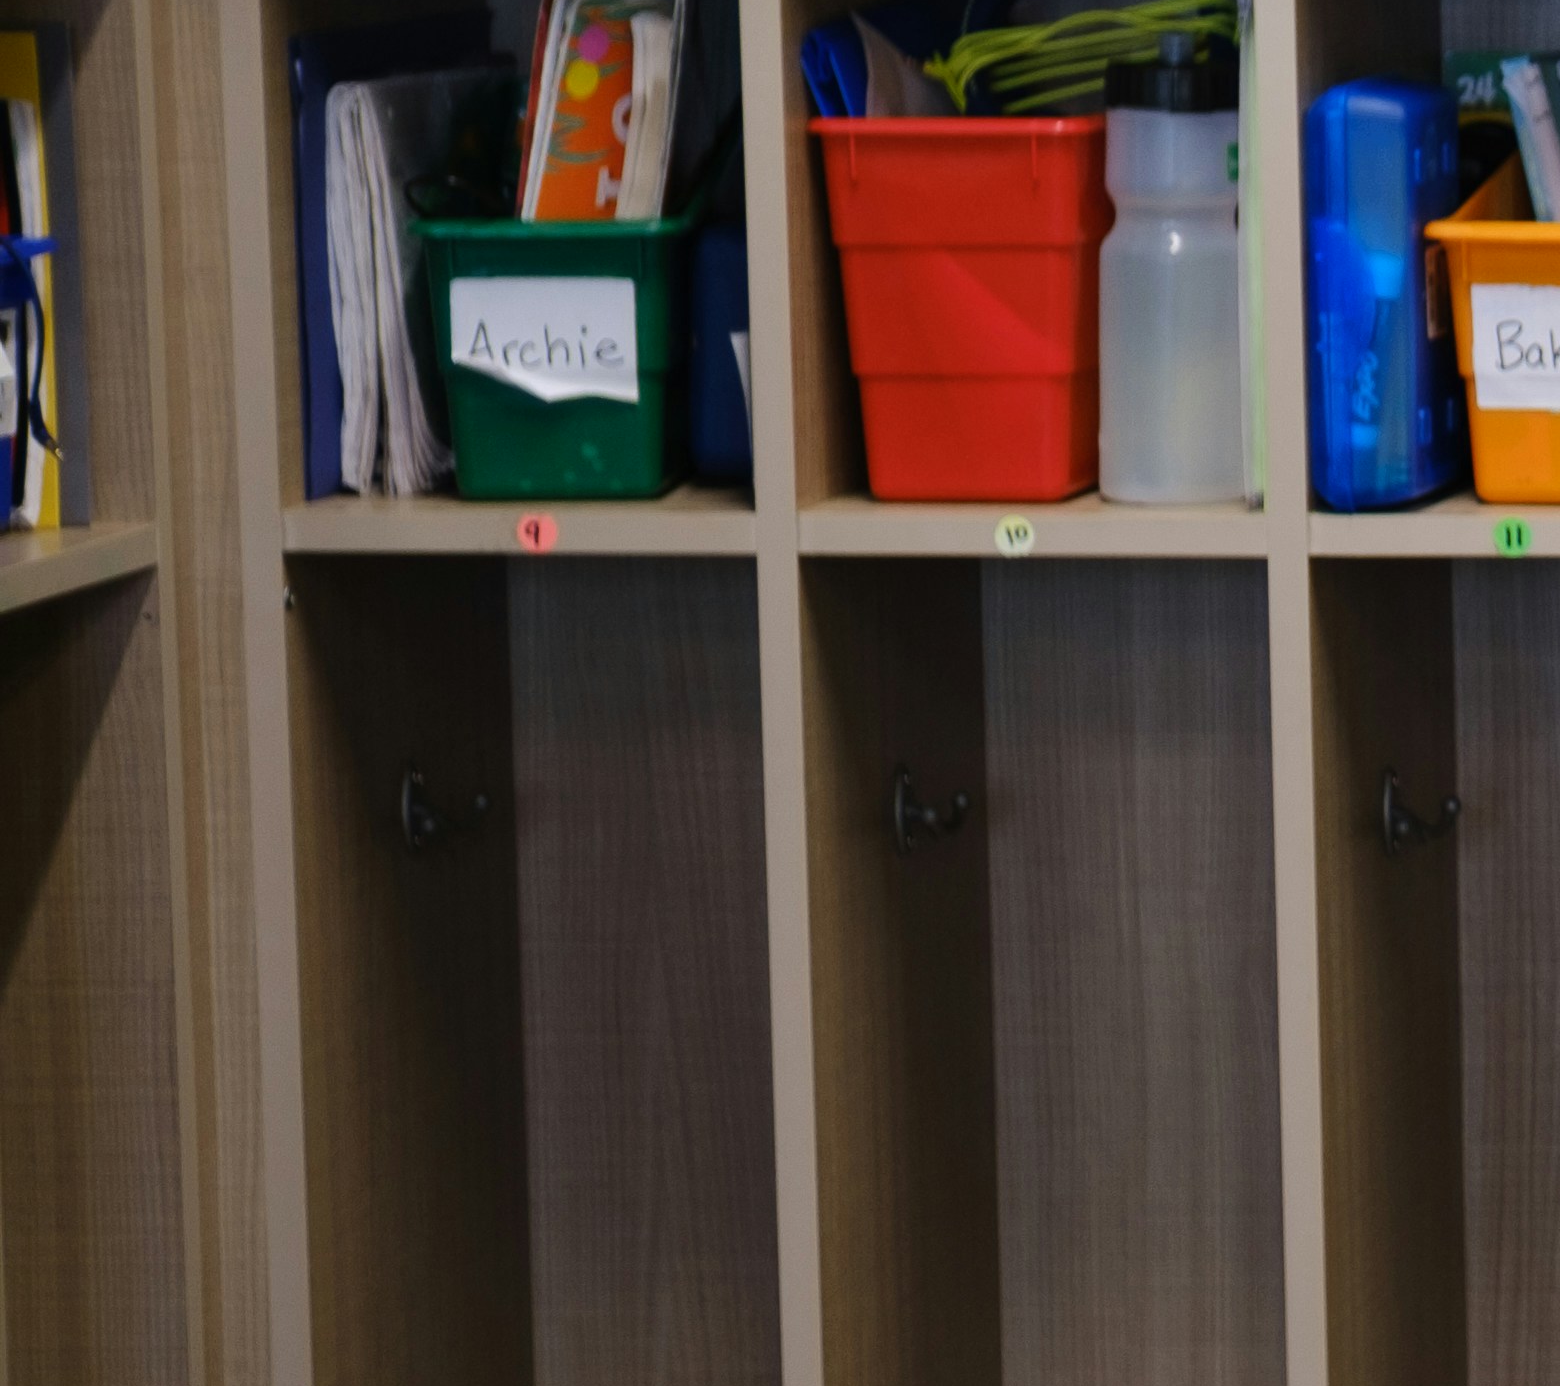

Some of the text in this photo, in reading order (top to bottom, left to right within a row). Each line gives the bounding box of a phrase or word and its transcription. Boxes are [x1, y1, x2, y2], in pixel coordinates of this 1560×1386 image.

[468, 317, 625, 371] Archie
[524, 520, 542, 545] 9
[1004, 522, 1029, 545] 10
[1503, 526, 1524, 547] 11
